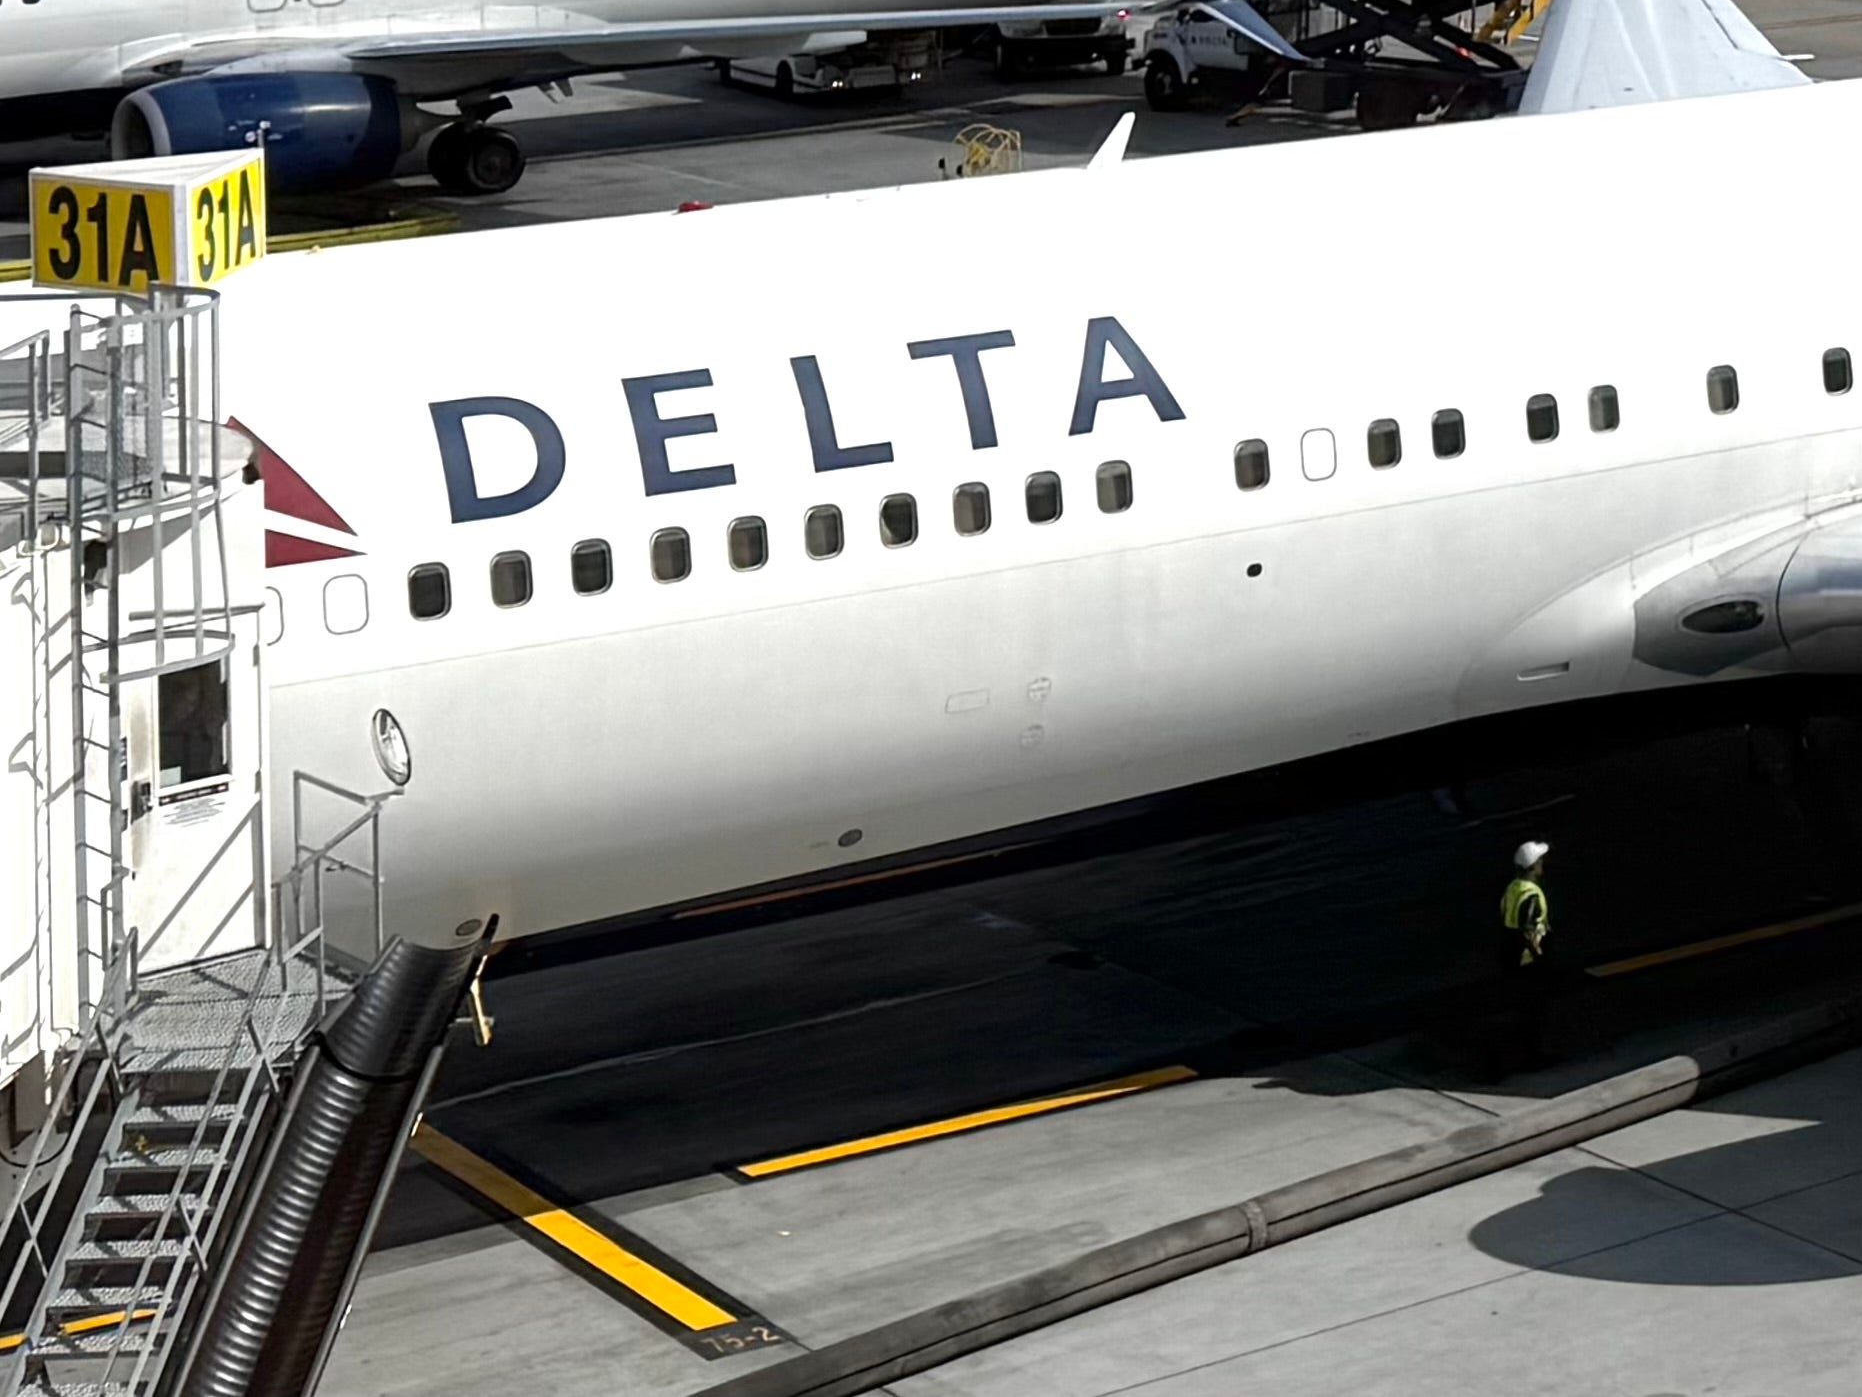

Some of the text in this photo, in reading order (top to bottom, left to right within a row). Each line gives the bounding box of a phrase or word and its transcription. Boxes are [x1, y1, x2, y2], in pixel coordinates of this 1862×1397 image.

[48, 186, 160, 286] 31A
[197, 169, 256, 282] 31A
[429, 315, 1186, 524] DELTA
